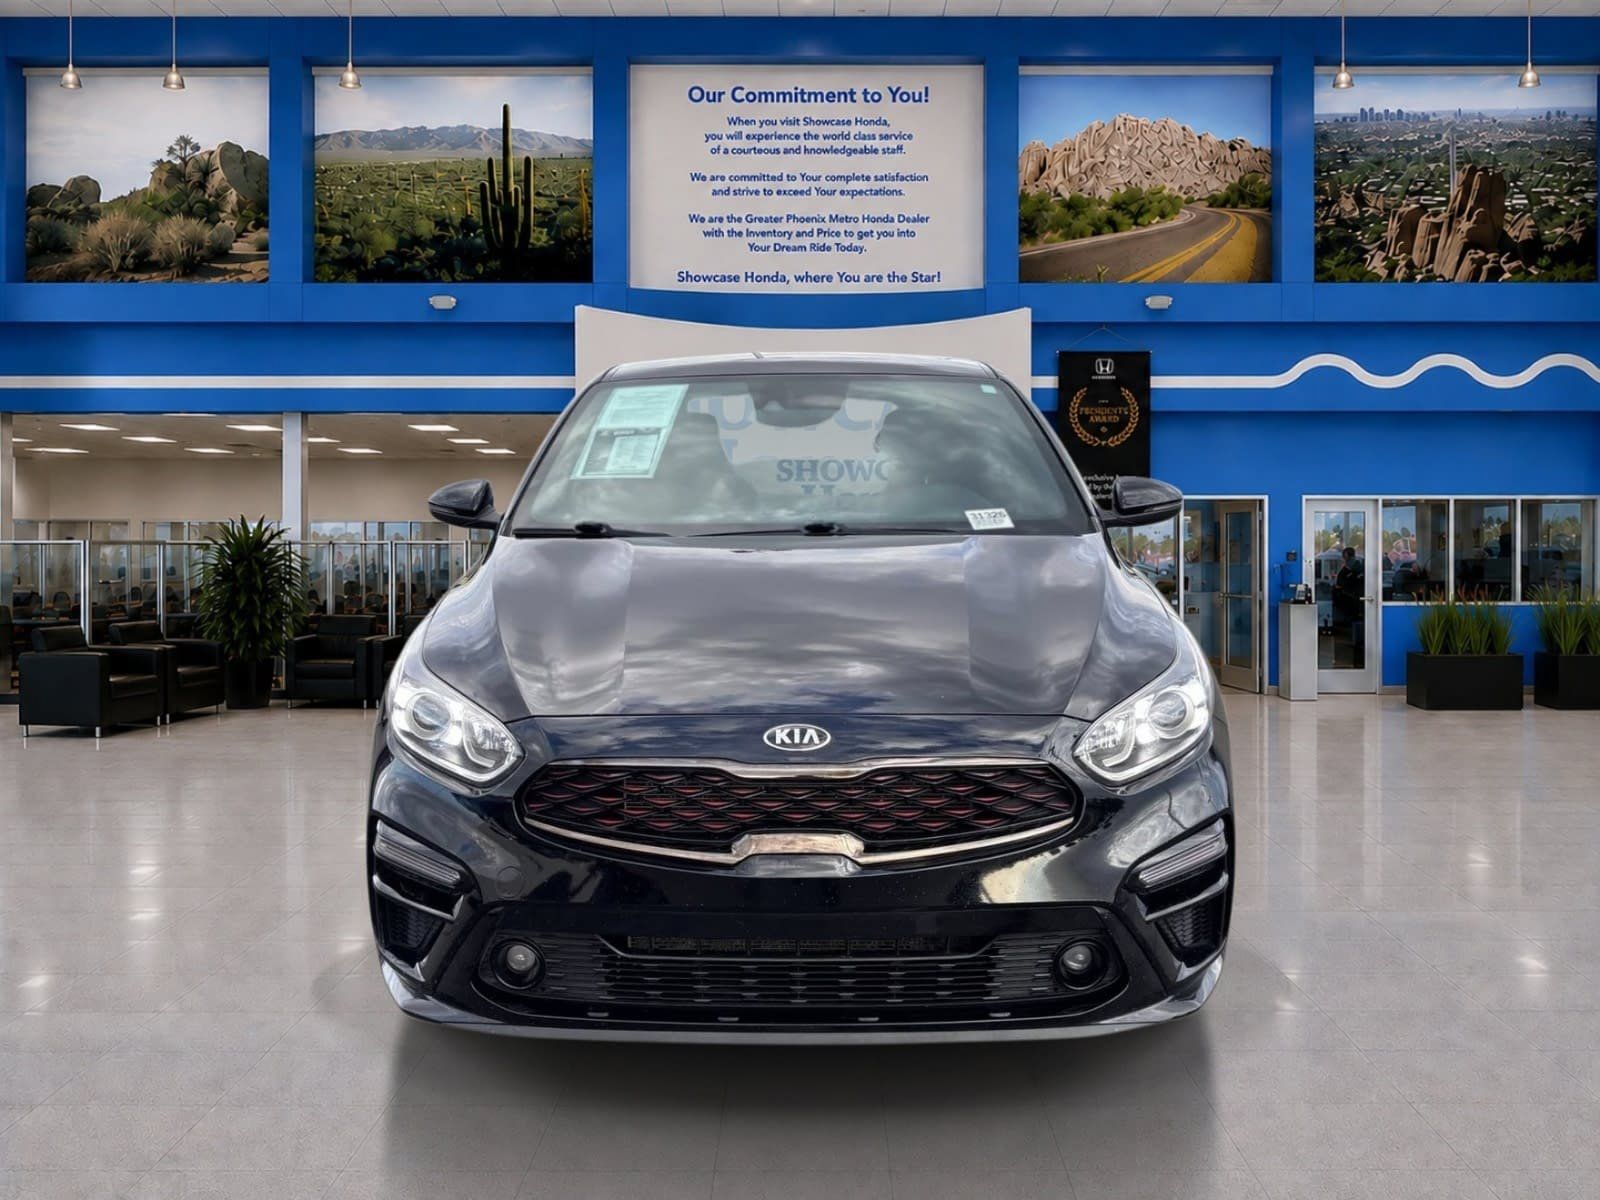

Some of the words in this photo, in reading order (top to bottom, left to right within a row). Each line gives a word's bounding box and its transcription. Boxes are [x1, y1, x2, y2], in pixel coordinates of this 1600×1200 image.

[688, 85, 726, 103] Our
[731, 86, 857, 103] Commitment
[861, 88, 882, 103] to
[887, 86, 929, 103] You!
[727, 116, 756, 126] When
[758, 119, 777, 128] you
[779, 117, 800, 127] visit
[803, 116, 852, 127] Showcase
[855, 116, 890, 128] Honda,
[705, 133, 723, 142] you
[725, 130, 743, 141] will
[745, 131, 801, 142] experience
[803, 131, 820, 141] the
[822, 131, 851, 141] world
[853, 131, 877, 141] class
[878, 131, 913, 141] service
[710, 144, 721, 155] of
[723, 146, 729, 155] a
[731, 146, 781, 155] courteous
[783, 145, 802, 155] and
[881, 144, 906, 155] staff.
[689, 172, 707, 182] We
[728, 172, 783, 182] committed
[786, 174, 797, 182] to
[799, 172, 822, 182] Your
[825, 172, 871, 184] complete
[874, 172, 928, 182] satisfaction
[712, 186, 731, 196] and
[732, 186, 760, 196] strive
[763, 188, 774, 196] to
[776, 186, 812, 196] exceed
[814, 186, 837, 196] Your
[839, 186, 905, 198] expectations.
[688, 214, 706, 223] We
[707, 216, 724, 224] are
[726, 213, 743, 224] the
[745, 214, 784, 224] Greater
[786, 213, 826, 224] Phoenix
[829, 214, 859, 224] Metro
[862, 214, 895, 224] Honda
[897, 213, 930, 224] Dealer
[702, 227, 724, 238] with
[727, 227, 744, 238] the
[746, 228, 793, 240] Inventory
[795, 227, 814, 239] and
[816, 228, 841, 238] Price
[844, 229, 855, 238] to
[857, 229, 874, 240] get
[876, 230, 895, 240] you
[897, 228, 916, 238] into
[748, 242, 771, 252] Your
[773, 242, 807, 252] Dream
[809, 242, 832, 252] Ride
[833, 242, 867, 255] Today.
[677, 270, 741, 285] Showcase
[745, 271, 790, 285] Honda,
[794, 271, 833, 283] where
[837, 272, 861, 283] You
[864, 274, 883, 283] are
[886, 271, 908, 283] the
[911, 271, 941, 283] Star!
[775, 728, 820, 744] KIA
